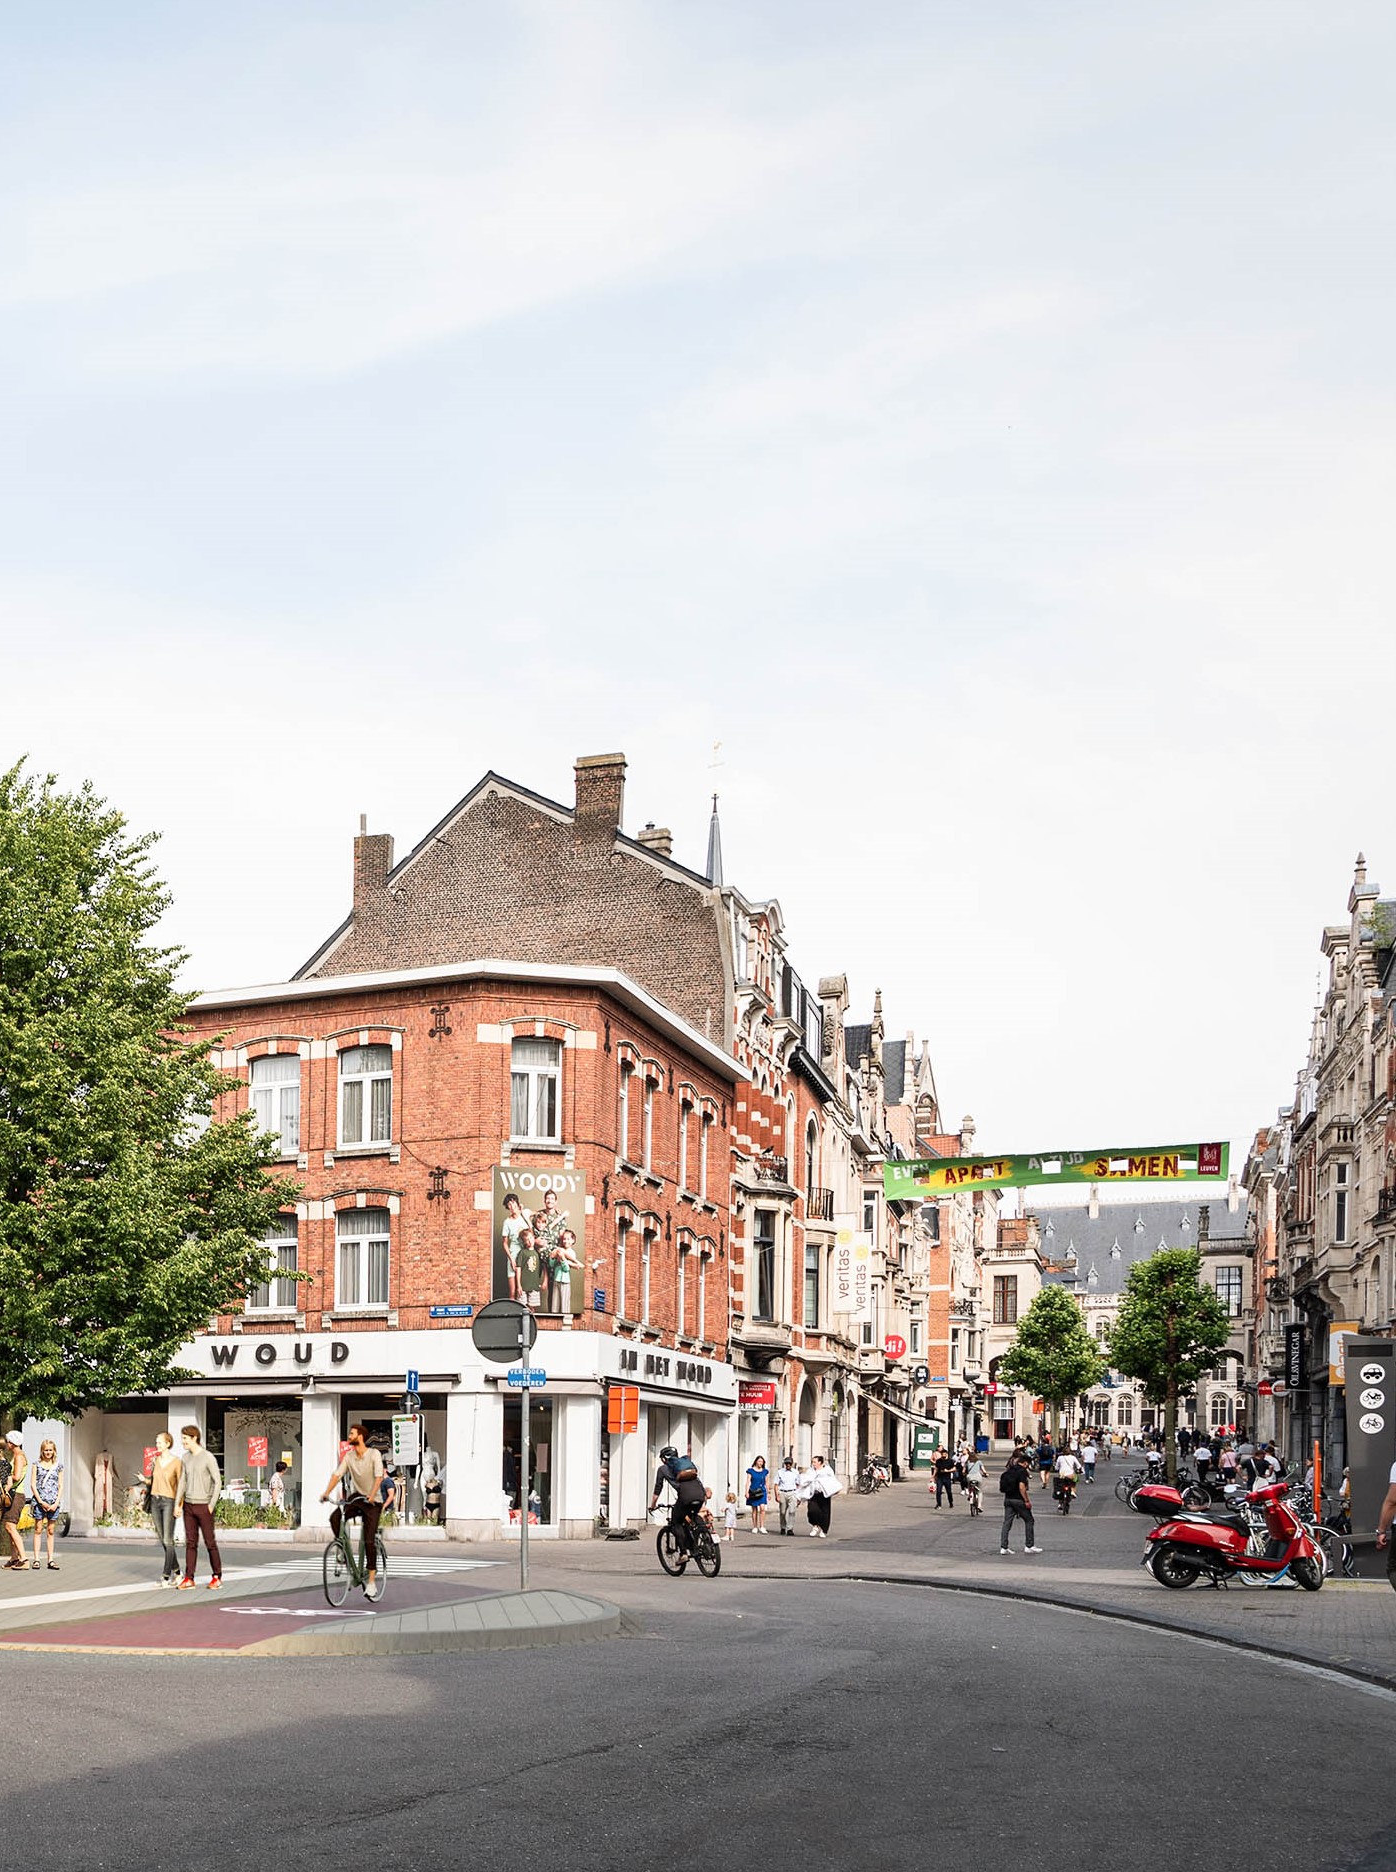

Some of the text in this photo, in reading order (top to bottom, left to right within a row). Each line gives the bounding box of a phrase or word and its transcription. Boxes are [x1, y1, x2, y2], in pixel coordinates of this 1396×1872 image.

[499, 1171, 581, 1193] WOODY
[837, 1249, 850, 1299] veritas
[856, 1264, 867, 1312] veritas
[210, 1341, 350, 1366] WOUD
[646, 1354, 671, 1377] HET
[677, 1360, 713, 1384] WOUD
